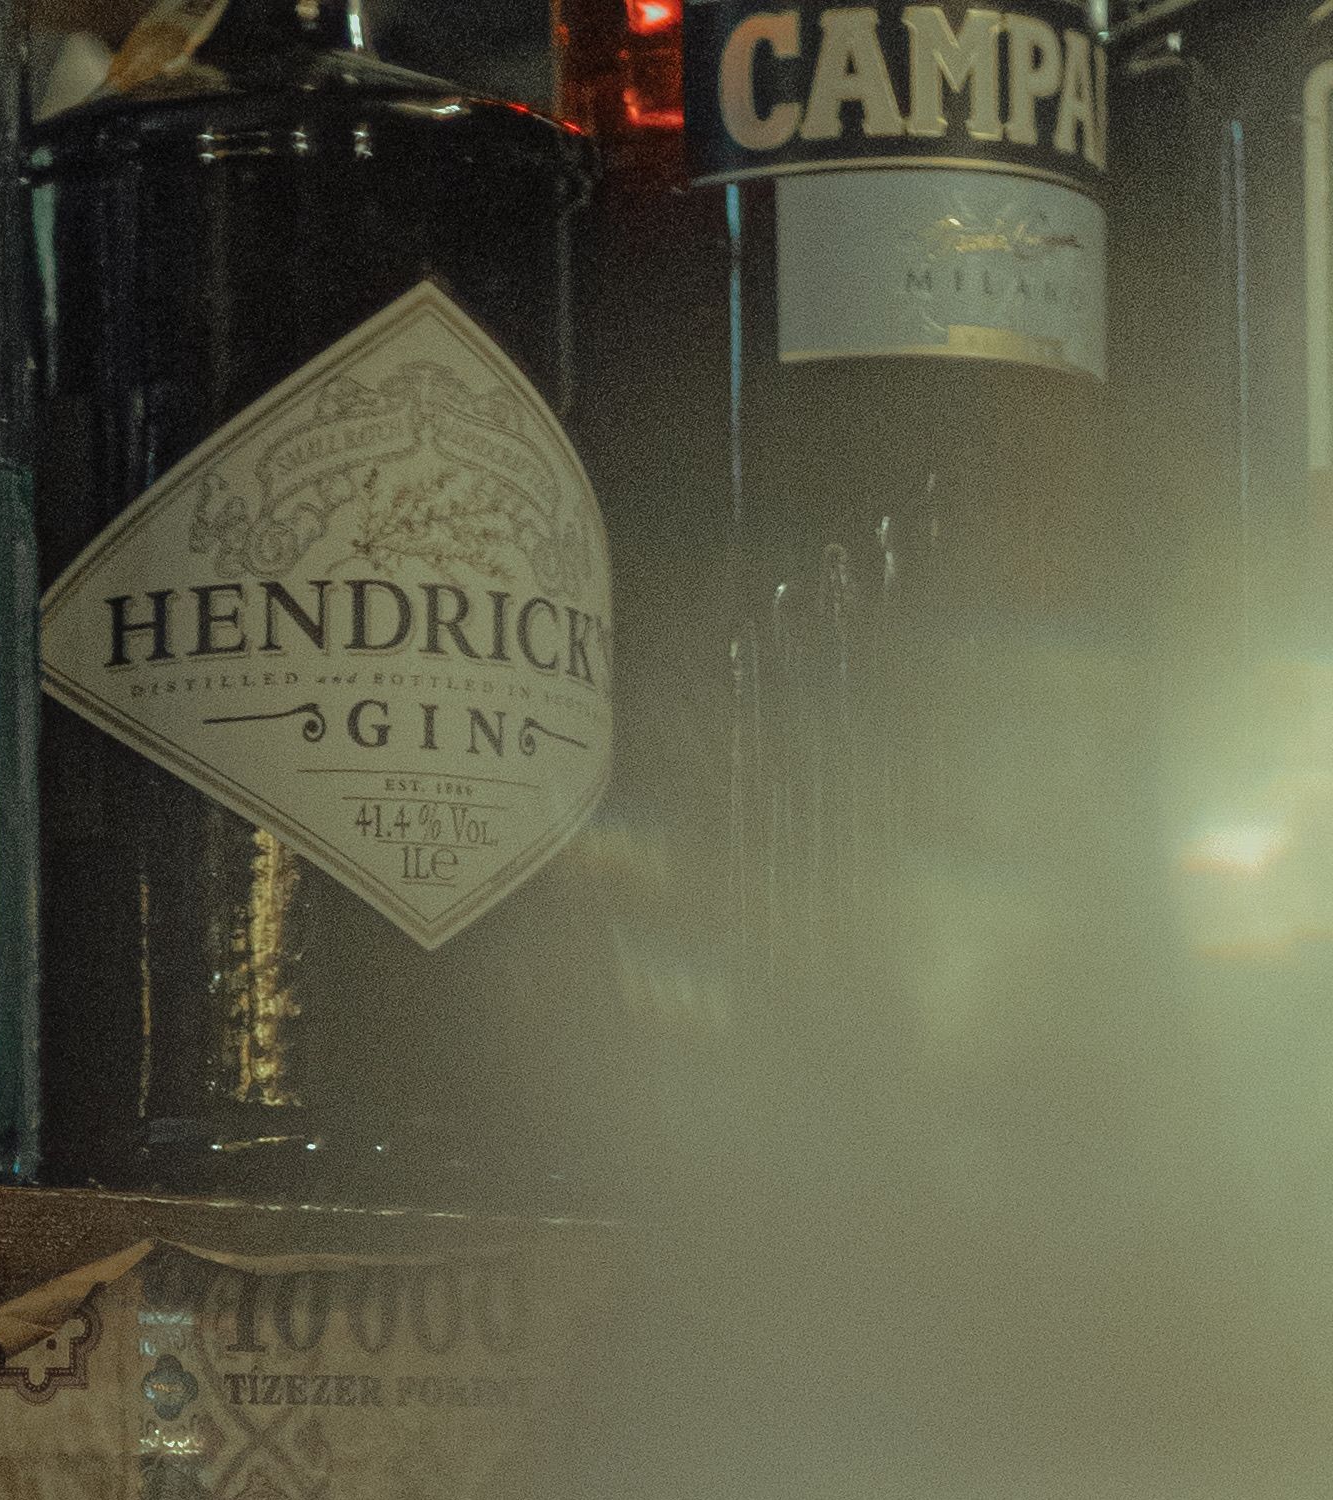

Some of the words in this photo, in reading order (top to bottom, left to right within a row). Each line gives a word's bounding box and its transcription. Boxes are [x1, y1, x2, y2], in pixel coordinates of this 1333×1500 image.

[720, 6, 1107, 171] CAMPA
[131, 671, 300, 698] DISTILLED
[345, 699, 508, 759] GIN
[353, 804, 412, 840] 41.4
[223, 1366, 384, 1407] TÍZEZER
